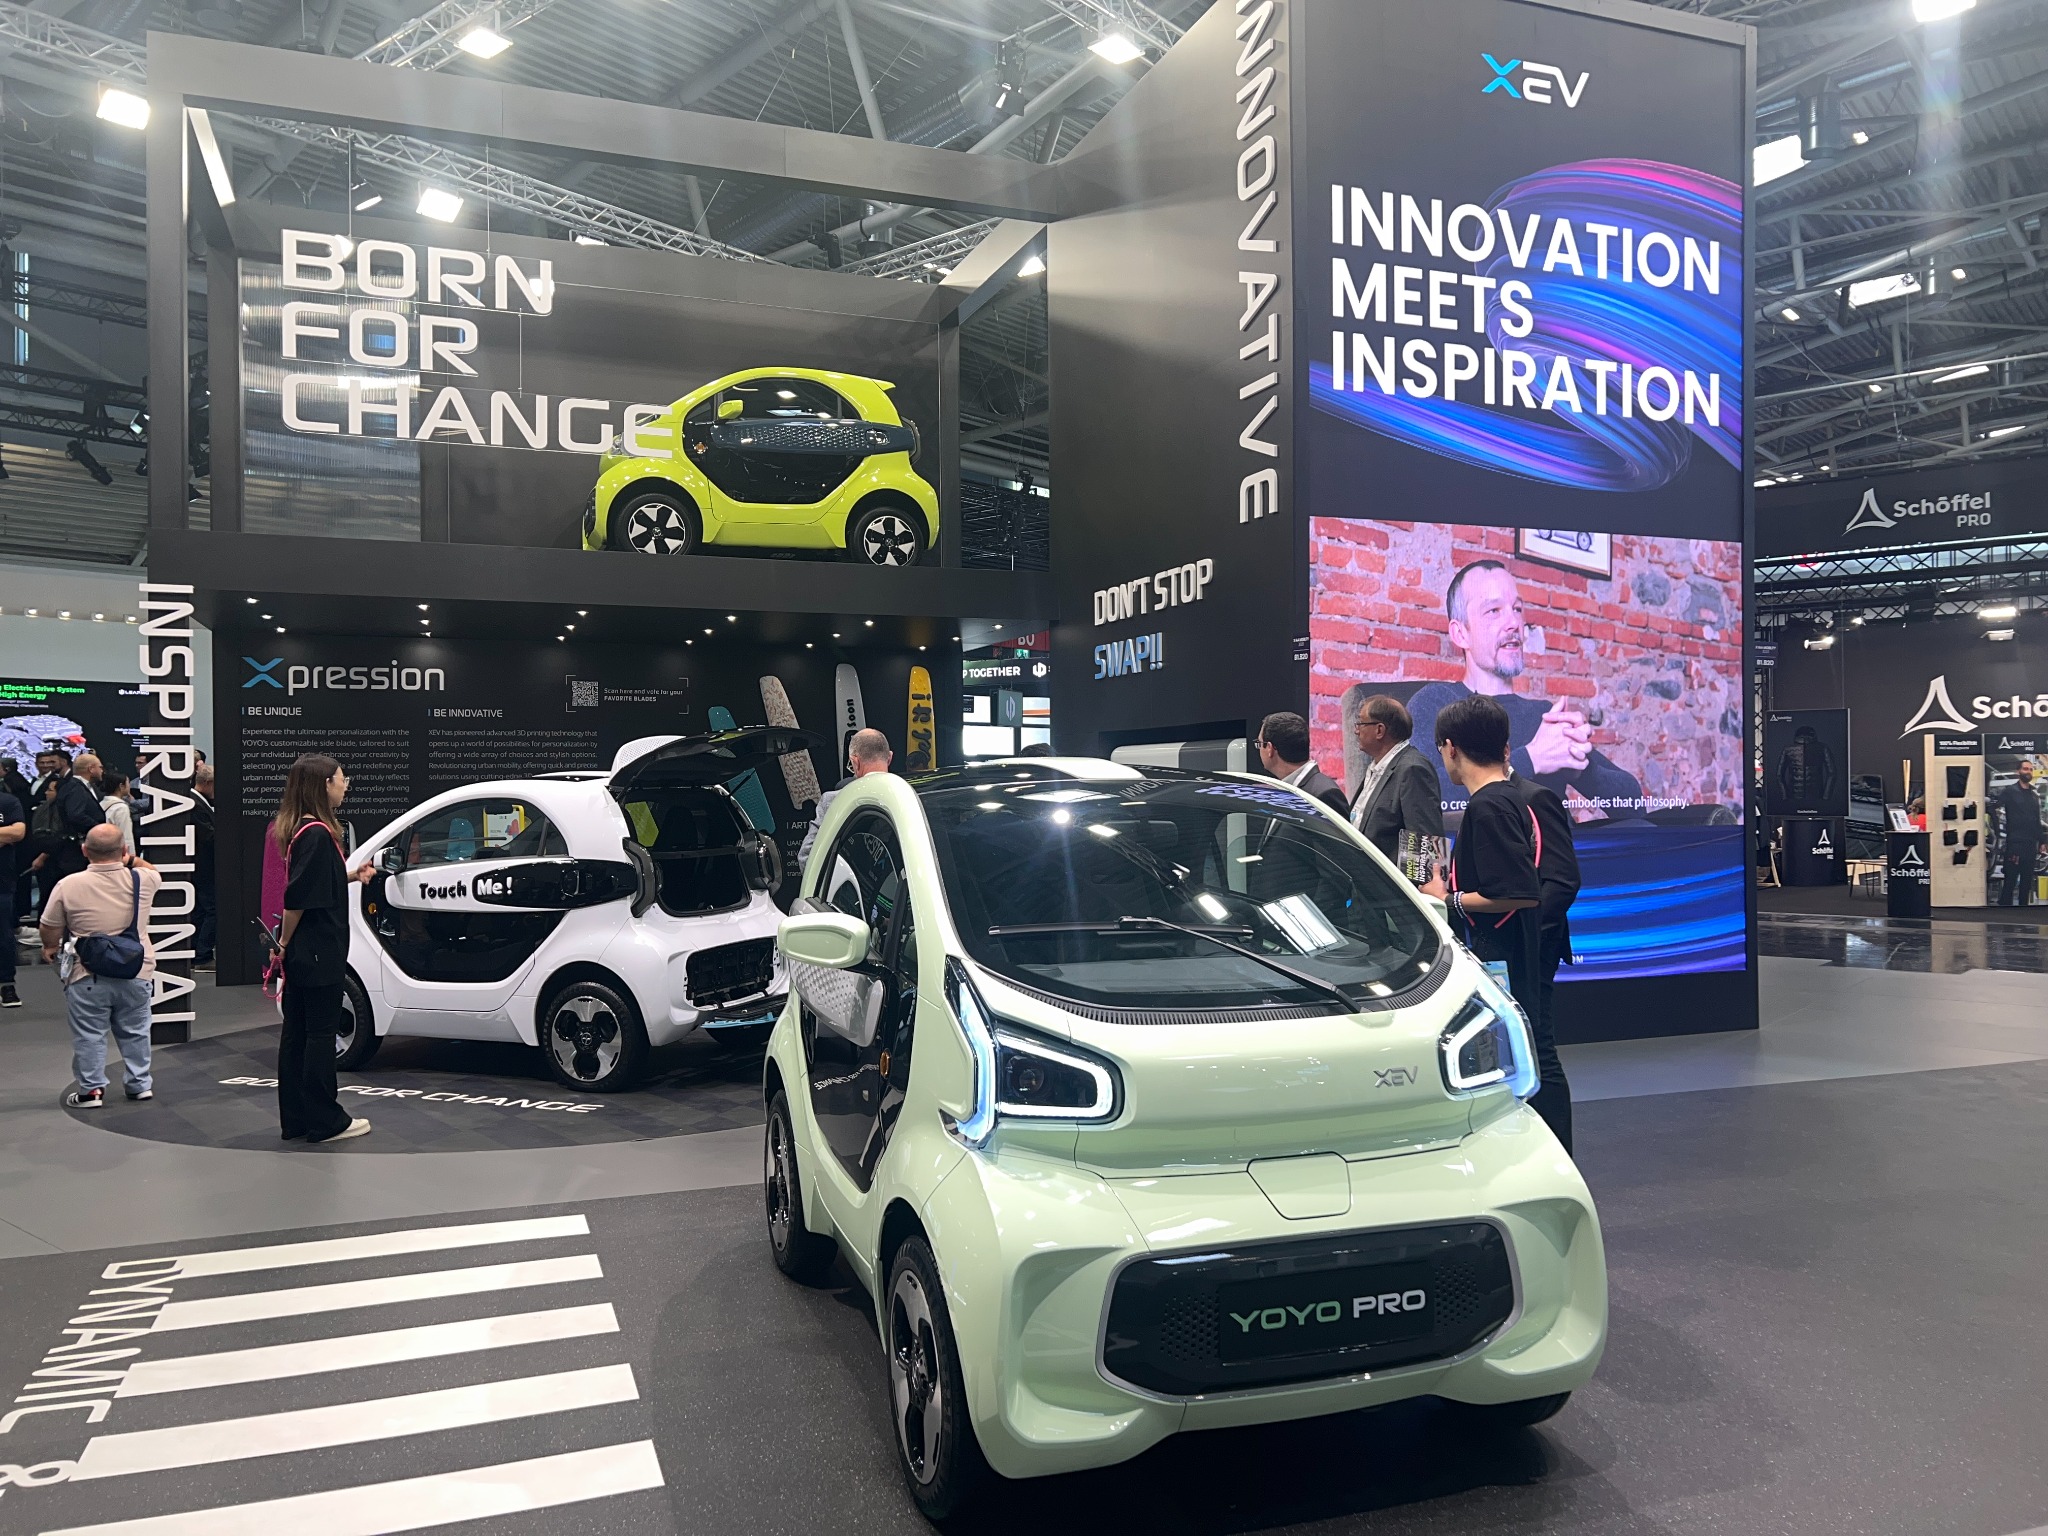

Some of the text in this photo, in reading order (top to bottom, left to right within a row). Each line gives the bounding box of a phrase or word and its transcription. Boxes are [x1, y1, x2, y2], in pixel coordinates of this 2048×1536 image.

[1481, 53, 1590, 108] XEV
[1331, 184, 1720, 294] INNOVATION
[281, 229, 552, 316] BORN
[1332, 257, 1534, 338] MEETS
[281, 302, 478, 377] FOR
[1332, 330, 1720, 427] INSPIRATION
[281, 373, 674, 458] CHANGE
[1957, 512, 1991, 527] PRO
[1094, 558, 1213, 626] DON'T STOP
[1094, 632, 1163, 680] SWAP!!
[969, 666, 1021, 678] TOGETHER
[4, 684, 33, 692] Electric
[57, 686, 85, 694] System
[19, 692, 47, 700] Energy
[248, 706, 303, 717] BE UNIQUE
[433, 708, 503, 718] BE INNOVATIVE
[846, 698, 856, 727] Soon
[242, 728, 282, 736] Experience
[551, 730, 584, 738] technology
[429, 751, 455, 759] offering
[523, 762, 547, 770] offering
[386, 785, 409, 793] driving
[1562, 796, 1611, 809] embodies
[1612, 796, 1632, 808] that
[1634, 795, 1690, 811] philosophy.
[1406, 832, 1415, 879] INNOVATION
[1419, 835, 1429, 882] INSPIRATION
[1412, 857, 1420, 881] MEETS
[419, 877, 513, 900] Touch Me!
[1373, 1065, 1419, 1088] XEV
[338, 1084, 423, 1100] FOR
[421, 1092, 604, 1113] CHANGE
[1229, 1289, 1426, 1333] YOYO PRO
[0, 1256, 186, 1433] DYNAMIC
